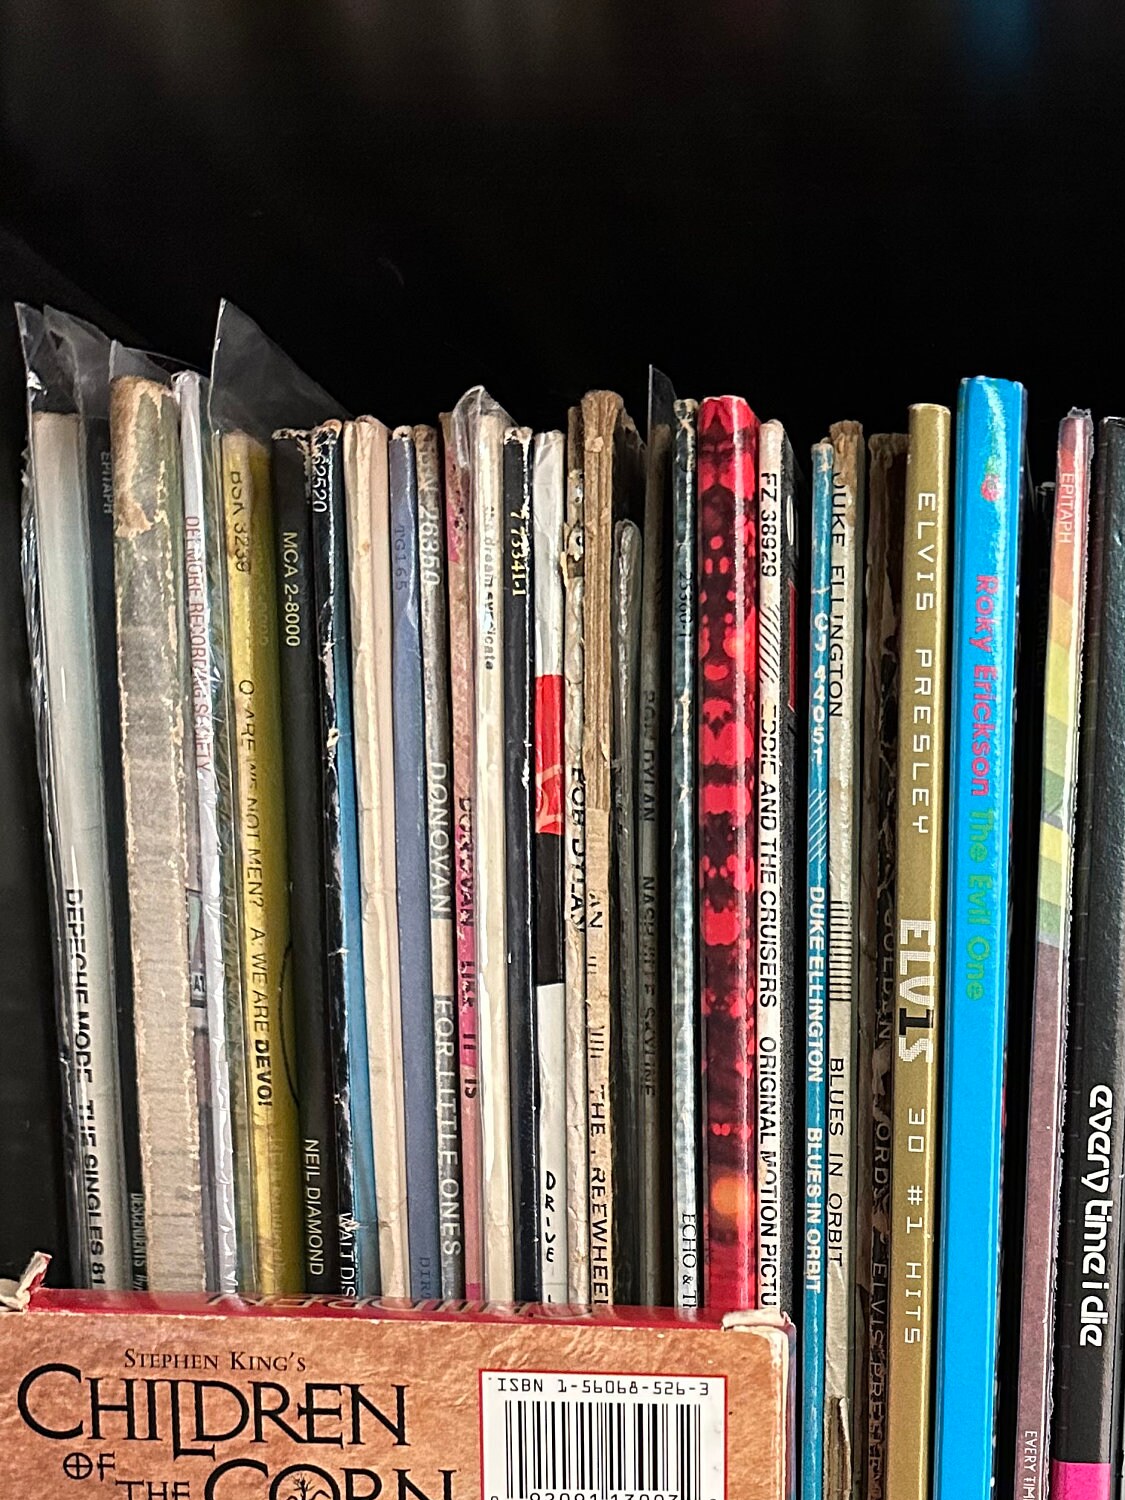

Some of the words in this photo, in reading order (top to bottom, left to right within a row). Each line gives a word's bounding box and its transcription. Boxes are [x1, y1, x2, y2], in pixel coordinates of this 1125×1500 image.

[761, 473, 777, 502] FZ
[1058, 472, 1075, 543] EPITAPH
[283, 532, 300, 577] MCA
[761, 509, 777, 577] 38929
[916, 492, 936, 612] ELVIS
[285, 584, 300, 646] 2-8000
[970, 574, 999, 650] Roky
[912, 648, 932, 834] PRESLEY
[971, 665, 996, 797] Erickson
[760, 781, 776, 831] AND
[967, 807, 993, 862] The
[761, 838, 776, 884] THE
[810, 886, 825, 951] DUKE
[967, 874, 992, 925] Evil
[251, 953, 267, 987] WE
[760, 889, 777, 1008] CRUISERS
[966, 936, 989, 1001] One
[253, 989, 269, 1032] ARE
[808, 956, 825, 1082] ELLINGTON
[255, 1039, 272, 1107] DEVO!
[304, 1139, 321, 1183] NEIL
[908, 1107, 925, 1153] 30
[1081, 1084, 1114, 1192] every
[807, 1128, 824, 1197] BLUES
[306, 1187, 325, 1276] DIAMOND
[807, 1202, 823, 1223] IN
[907, 1185, 923, 1234] #1
[1082, 1200, 1112, 1274] time
[804, 1230, 822, 1293] ORBIT
[904, 1262, 921, 1345] HITS
[1079, 1296, 1110, 1347] die
[18, 1362, 410, 1457] CHILDREN
[496, 1379, 545, 1394] ISBN
[557, 1379, 709, 1397] 1-56068-526-3
[63, 1450, 115, 1480] OF
[1023, 1431, 1037, 1472] EVERY
